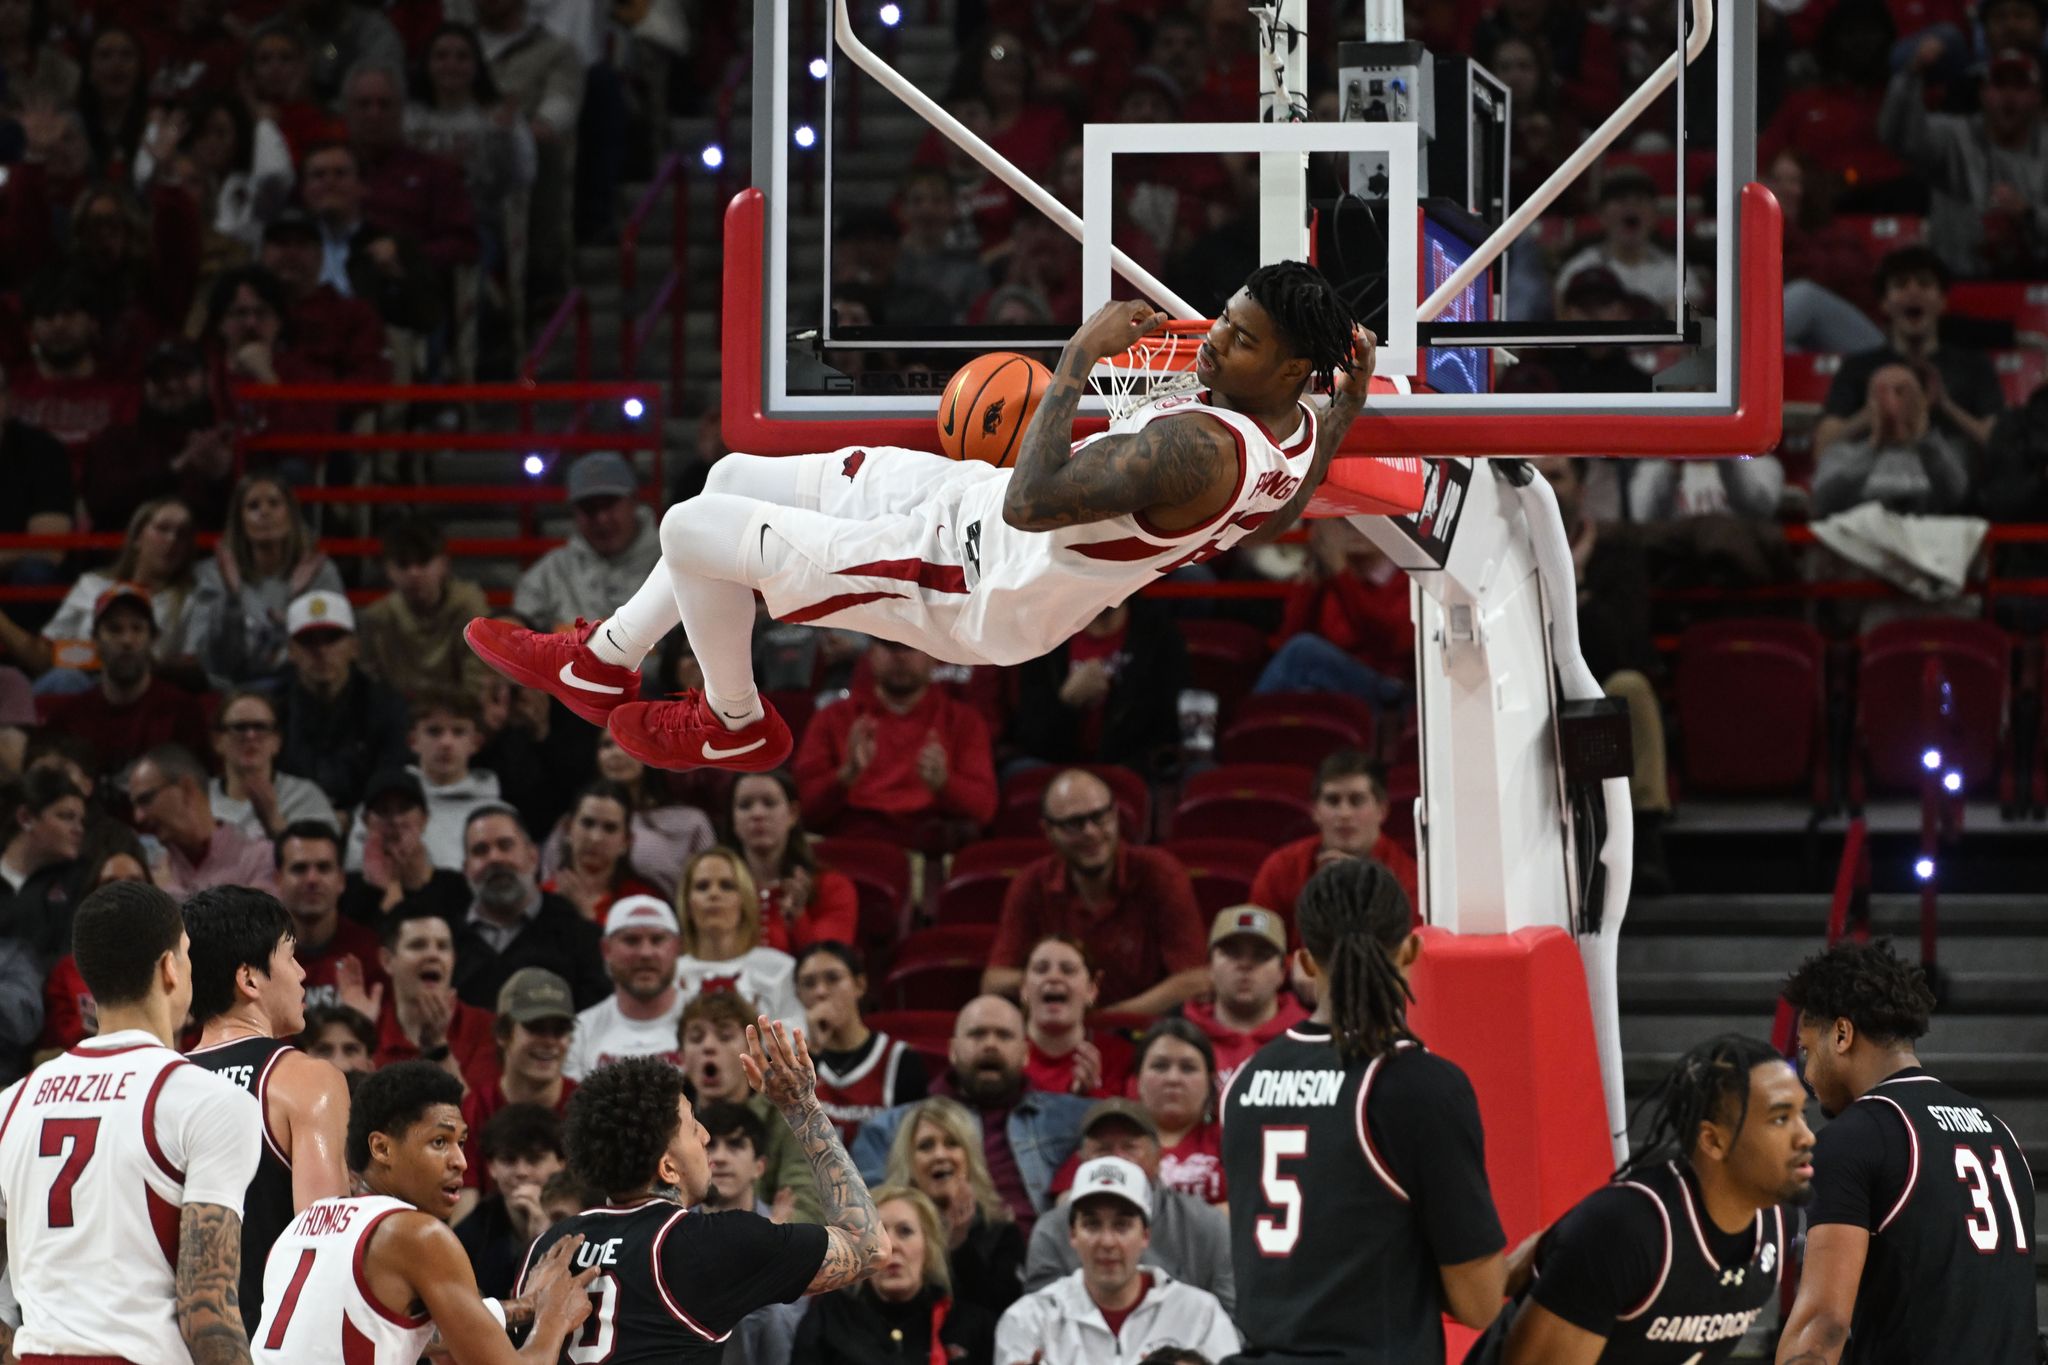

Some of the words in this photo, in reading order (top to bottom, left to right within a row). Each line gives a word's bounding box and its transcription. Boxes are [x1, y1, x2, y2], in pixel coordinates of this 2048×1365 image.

[861, 373, 947, 388] GARE
[33, 1071, 136, 1106] BRAZILE
[1239, 1070, 1346, 1106] JOHNSON
[1927, 1105, 1993, 1133] STRONG
[39, 1116, 102, 1229] 7
[1256, 1125, 1309, 1258] 5
[1952, 1144, 2029, 1255] 31
[264, 1248, 317, 1350] 1
